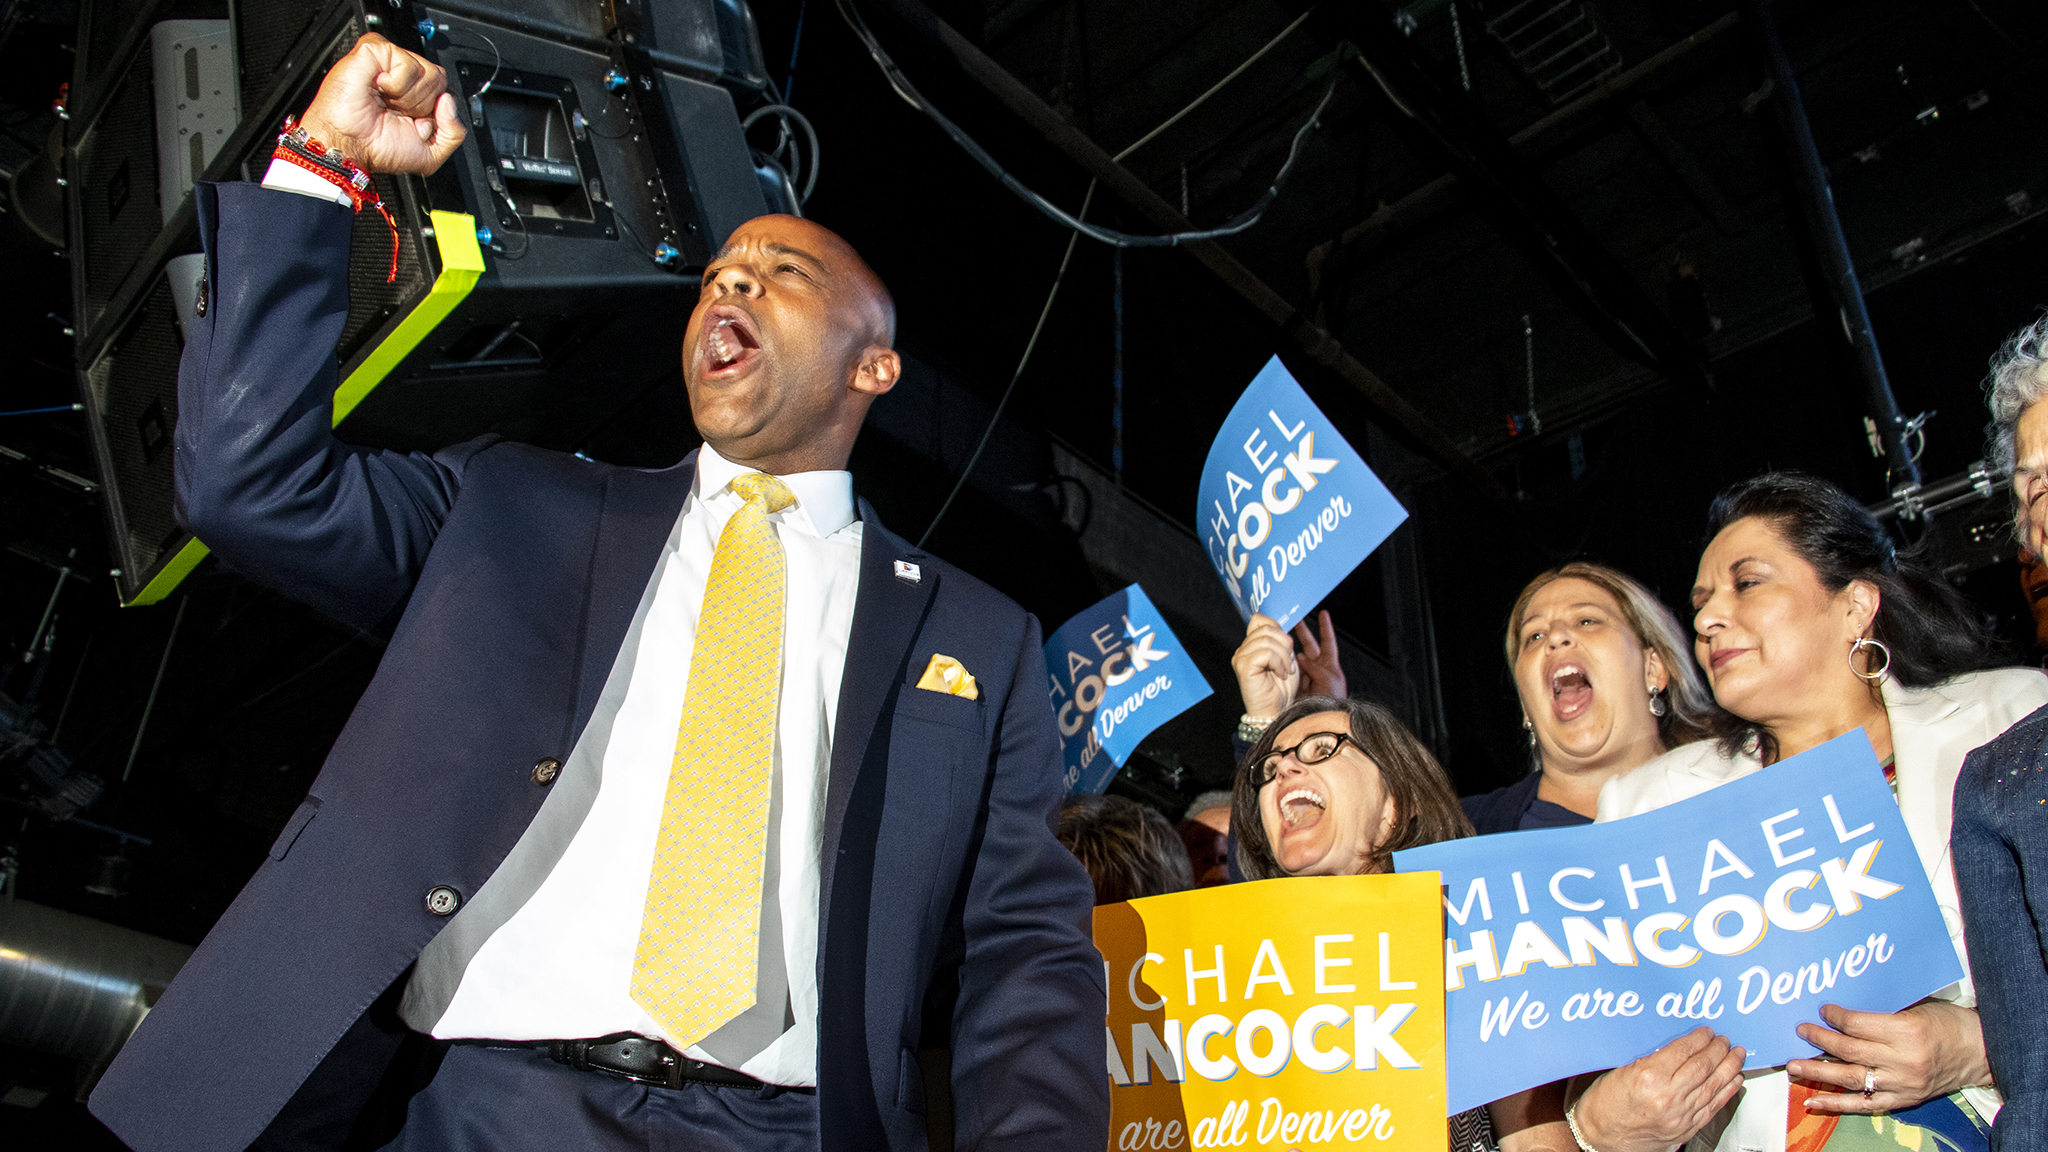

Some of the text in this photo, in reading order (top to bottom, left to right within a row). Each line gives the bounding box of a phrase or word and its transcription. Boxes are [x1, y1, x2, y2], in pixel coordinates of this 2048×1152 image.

[1208, 409, 1306, 575] CHAEL
[1225, 430, 1340, 599] NCOCK
[1268, 495, 1352, 582] Denver
[1049, 614, 1151, 698] HAEL
[1058, 632, 1171, 738] COCK
[1081, 725, 1103, 769] all
[1100, 675, 1172, 738] Denver
[1443, 794, 1876, 926] MICHAEL
[1445, 839, 1904, 992] HANCOCK
[1104, 932, 1418, 1016] ICHAEL
[1479, 931, 1895, 1043] We are all Denver
[1119, 1096, 1394, 1151] are all Denver
